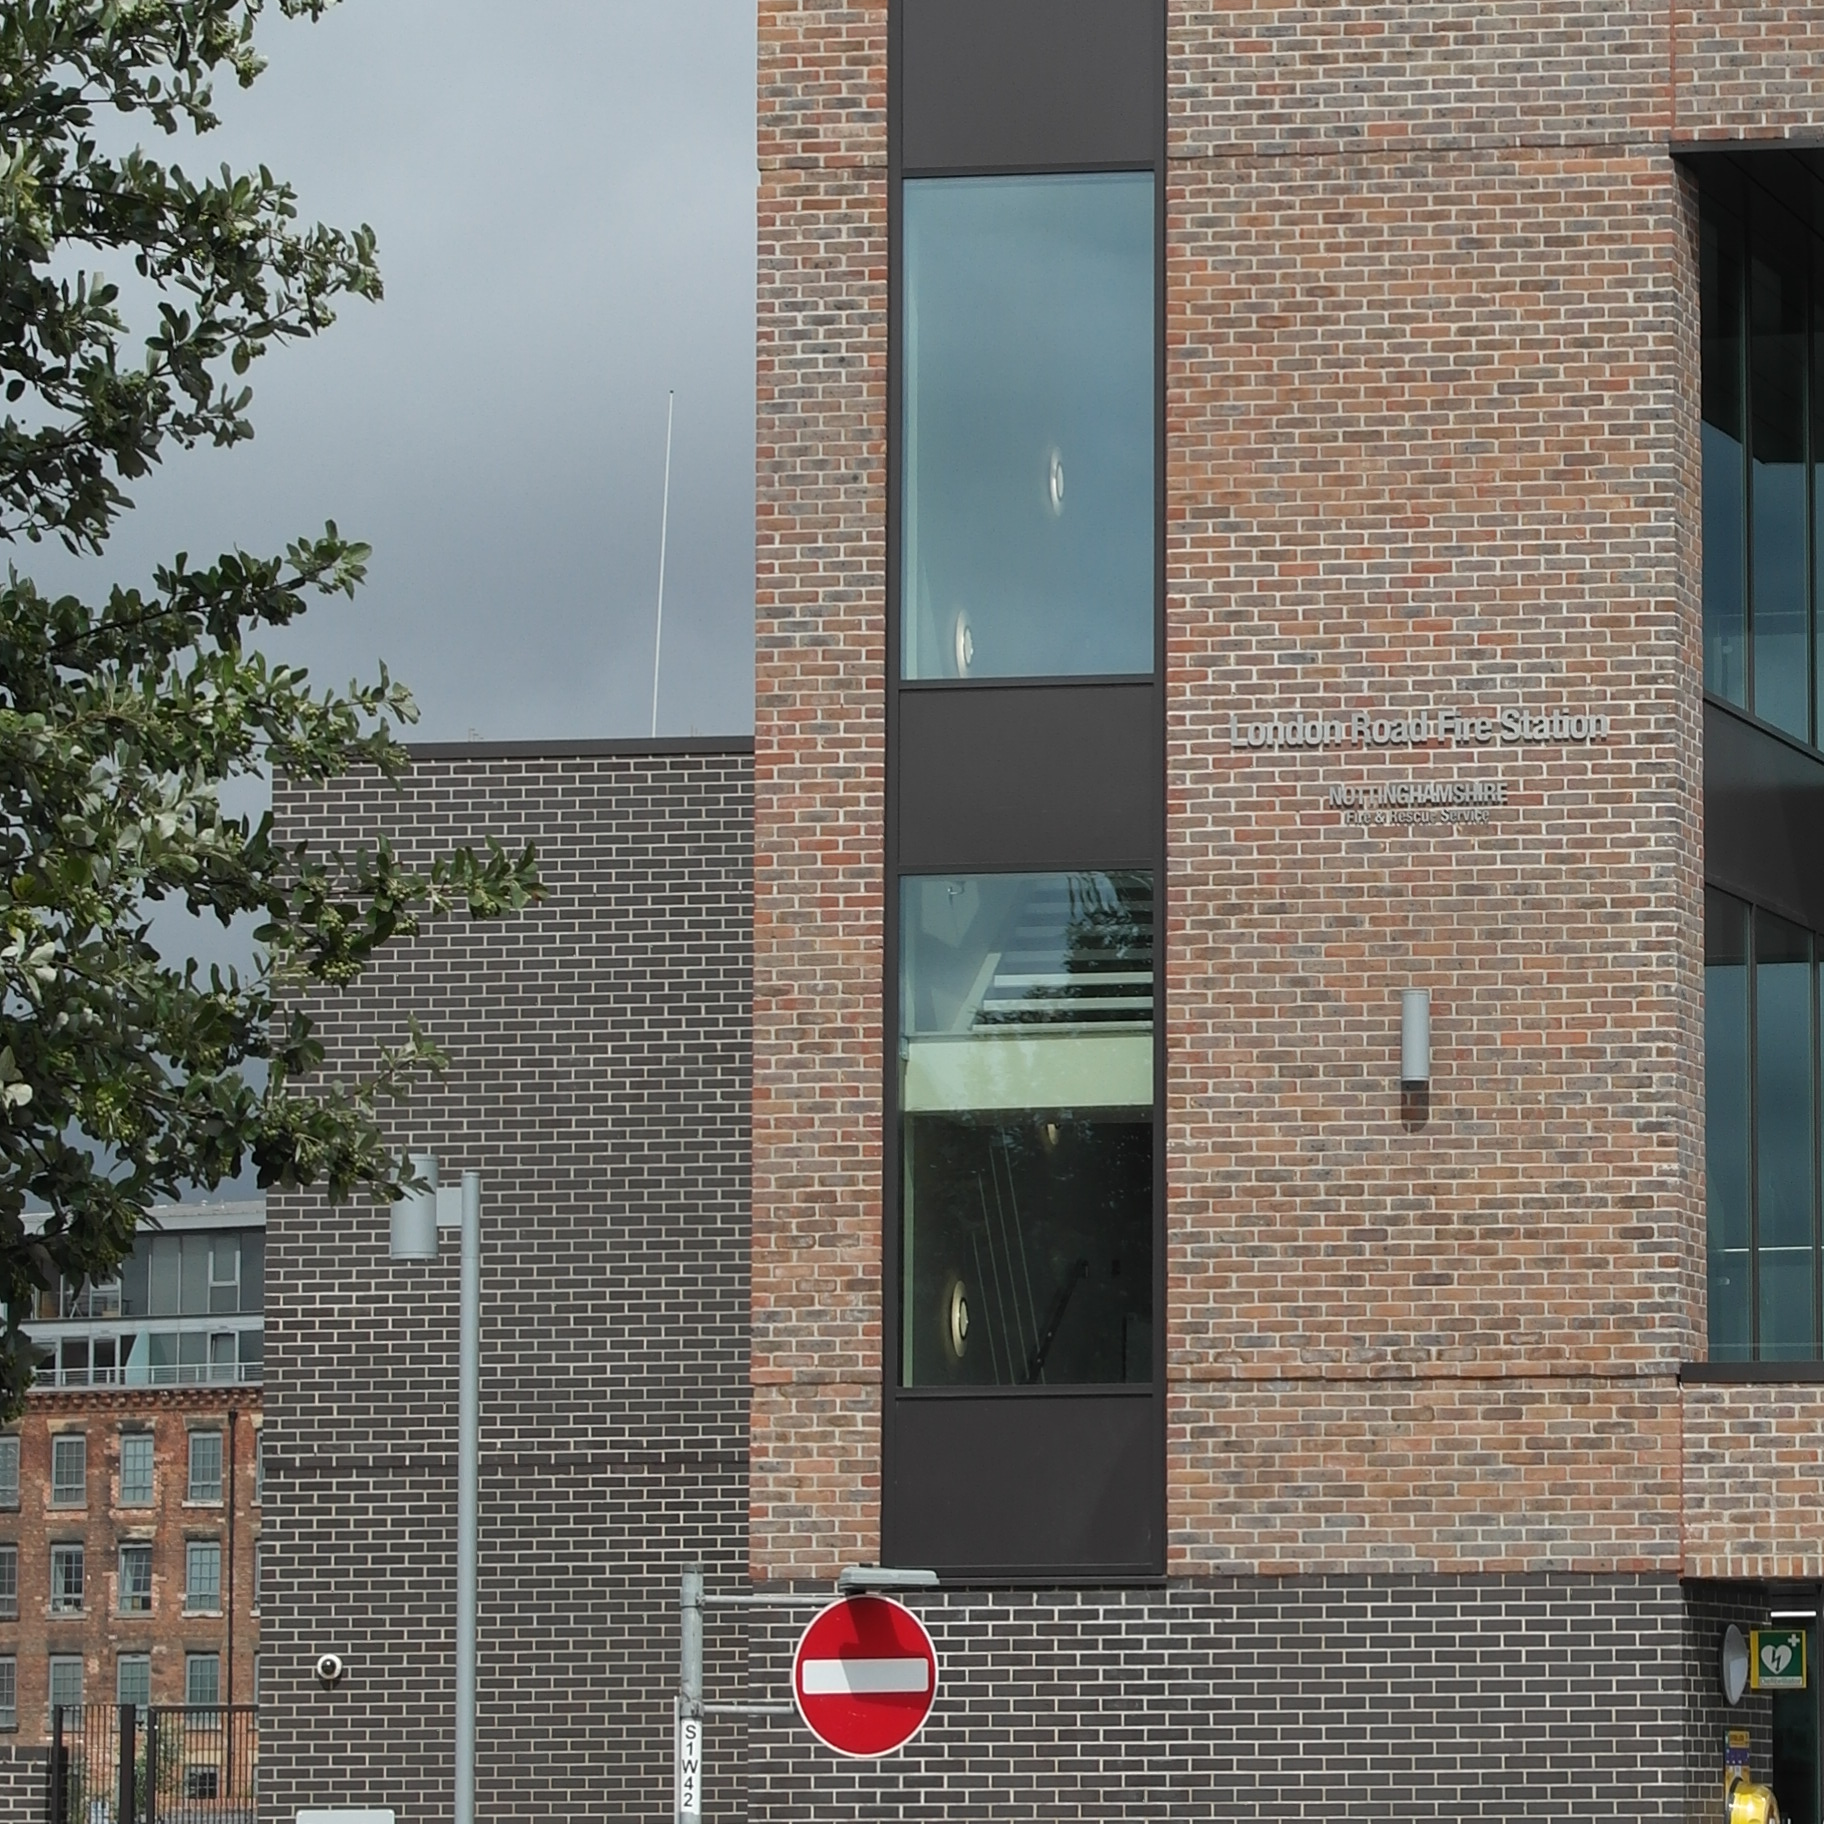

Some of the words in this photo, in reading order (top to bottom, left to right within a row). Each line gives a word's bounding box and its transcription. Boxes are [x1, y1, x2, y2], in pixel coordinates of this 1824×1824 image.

[1230, 713, 1343, 747] London
[1350, 710, 1428, 744] Road
[1437, 710, 1493, 742] Fire
[1500, 707, 1609, 741] Station
[1328, 782, 1508, 806] NOTTINGHAMSHIRE
[1346, 810, 1371, 824] Fire
[1374, 810, 1387, 824] &
[1440, 808, 1490, 823] Service
